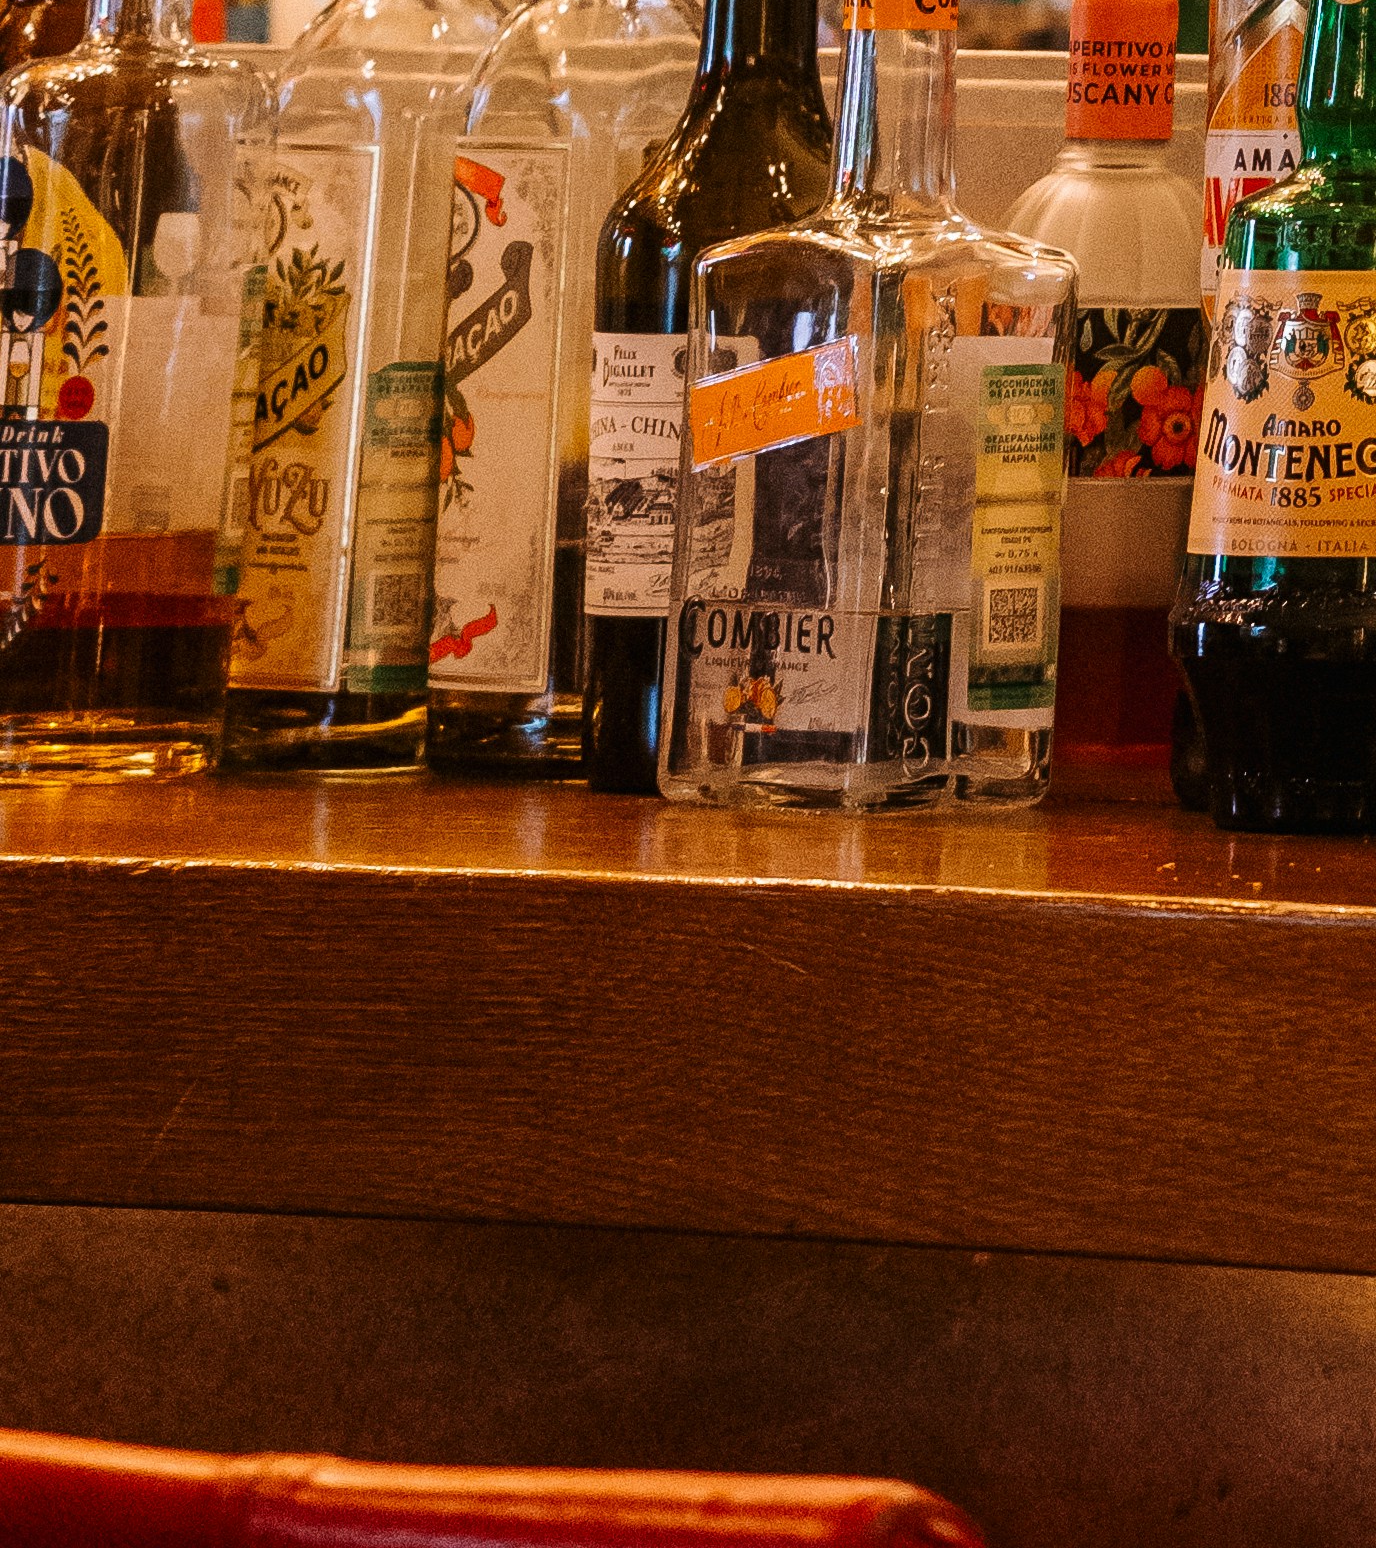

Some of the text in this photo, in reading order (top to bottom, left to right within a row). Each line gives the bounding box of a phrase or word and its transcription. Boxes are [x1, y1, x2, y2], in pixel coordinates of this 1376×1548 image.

[1069, 41, 1163, 58] PERITIVO
[1082, 63, 1162, 76] FLOWER
[1262, 413, 1342, 438] AMARO
[1002, 454, 1037, 464] МАРКА
[1270, 486, 1322, 507] 1885
[1231, 537, 1299, 552] BOLOGNA
[1316, 538, 1369, 553] ITALIA
[677, 595, 837, 659] COMBIER
